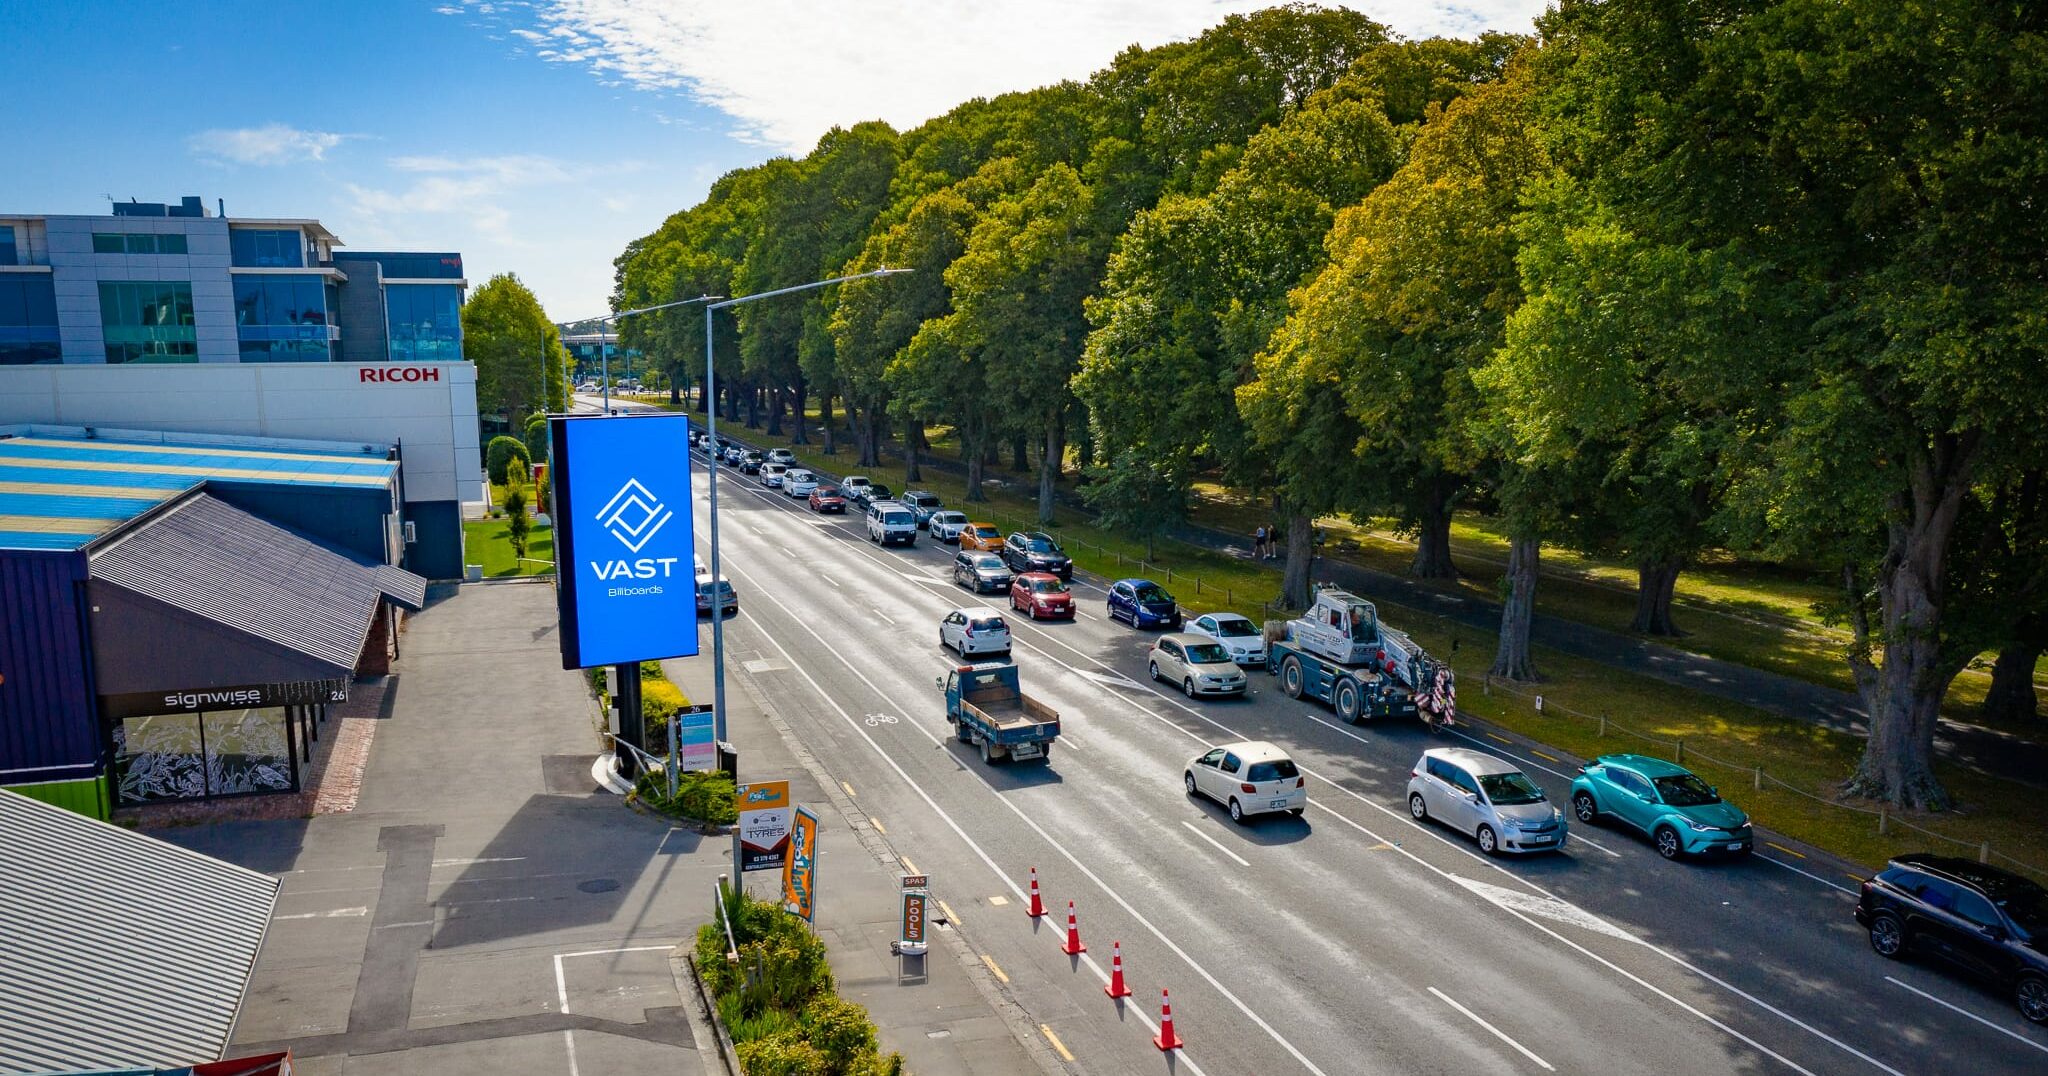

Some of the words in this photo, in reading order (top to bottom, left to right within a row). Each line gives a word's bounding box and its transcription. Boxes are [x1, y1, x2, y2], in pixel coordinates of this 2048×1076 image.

[360, 367, 439, 382] RICOH
[590, 557, 678, 581] VAST
[608, 585, 663, 597] Billboards
[165, 689, 261, 709] signwise
[331, 690, 345, 701] 26
[690, 705, 701, 713] 26
[746, 827, 785, 838] TYRES
[909, 899, 920, 938] POOLS
